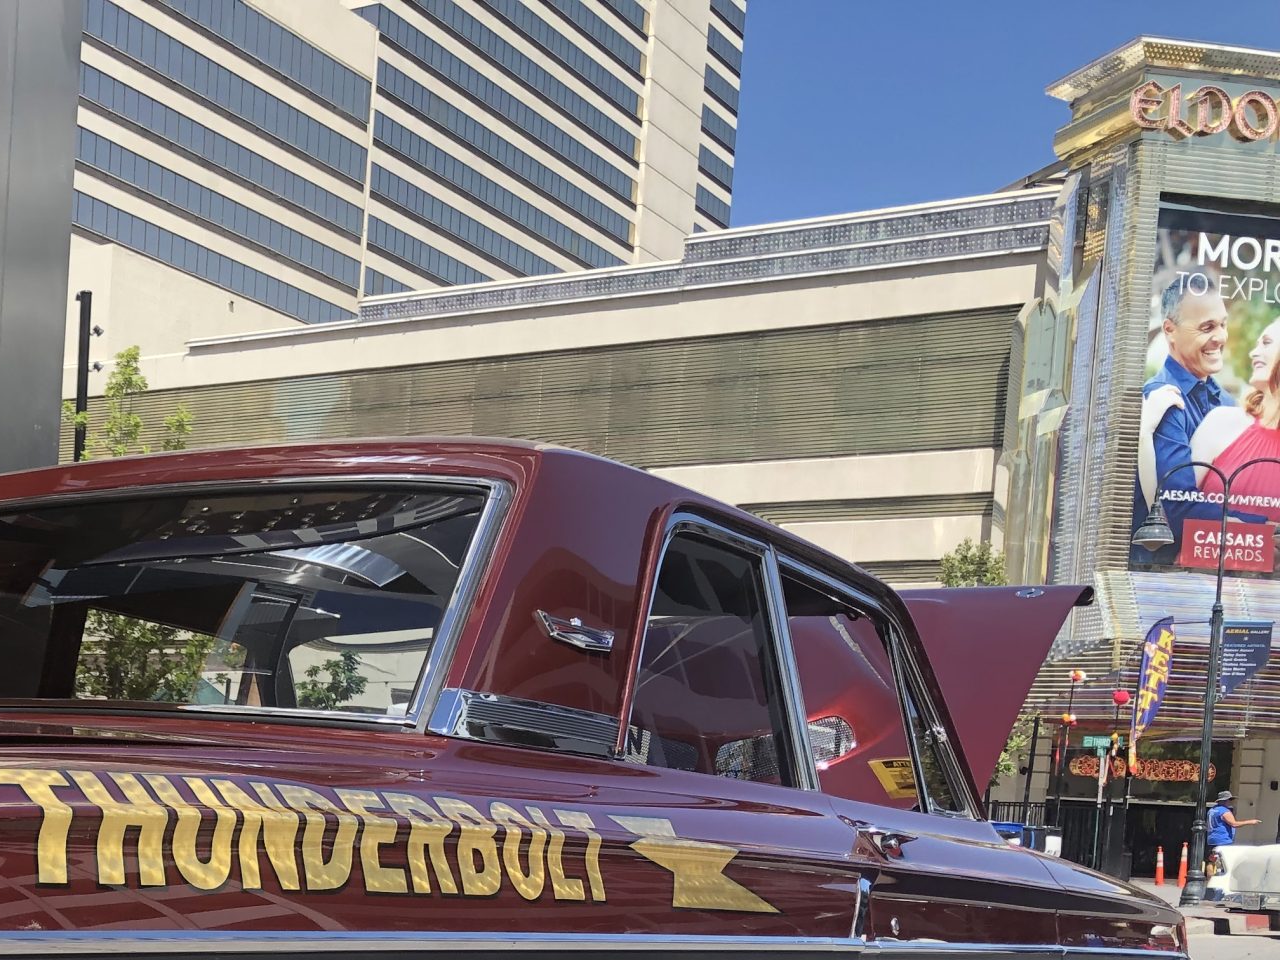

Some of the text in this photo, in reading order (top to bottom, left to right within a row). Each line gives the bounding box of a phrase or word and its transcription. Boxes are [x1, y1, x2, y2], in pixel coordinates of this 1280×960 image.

[1176, 271, 1280, 304] TO EXPL
[1193, 530, 1264, 547] CAESARS
